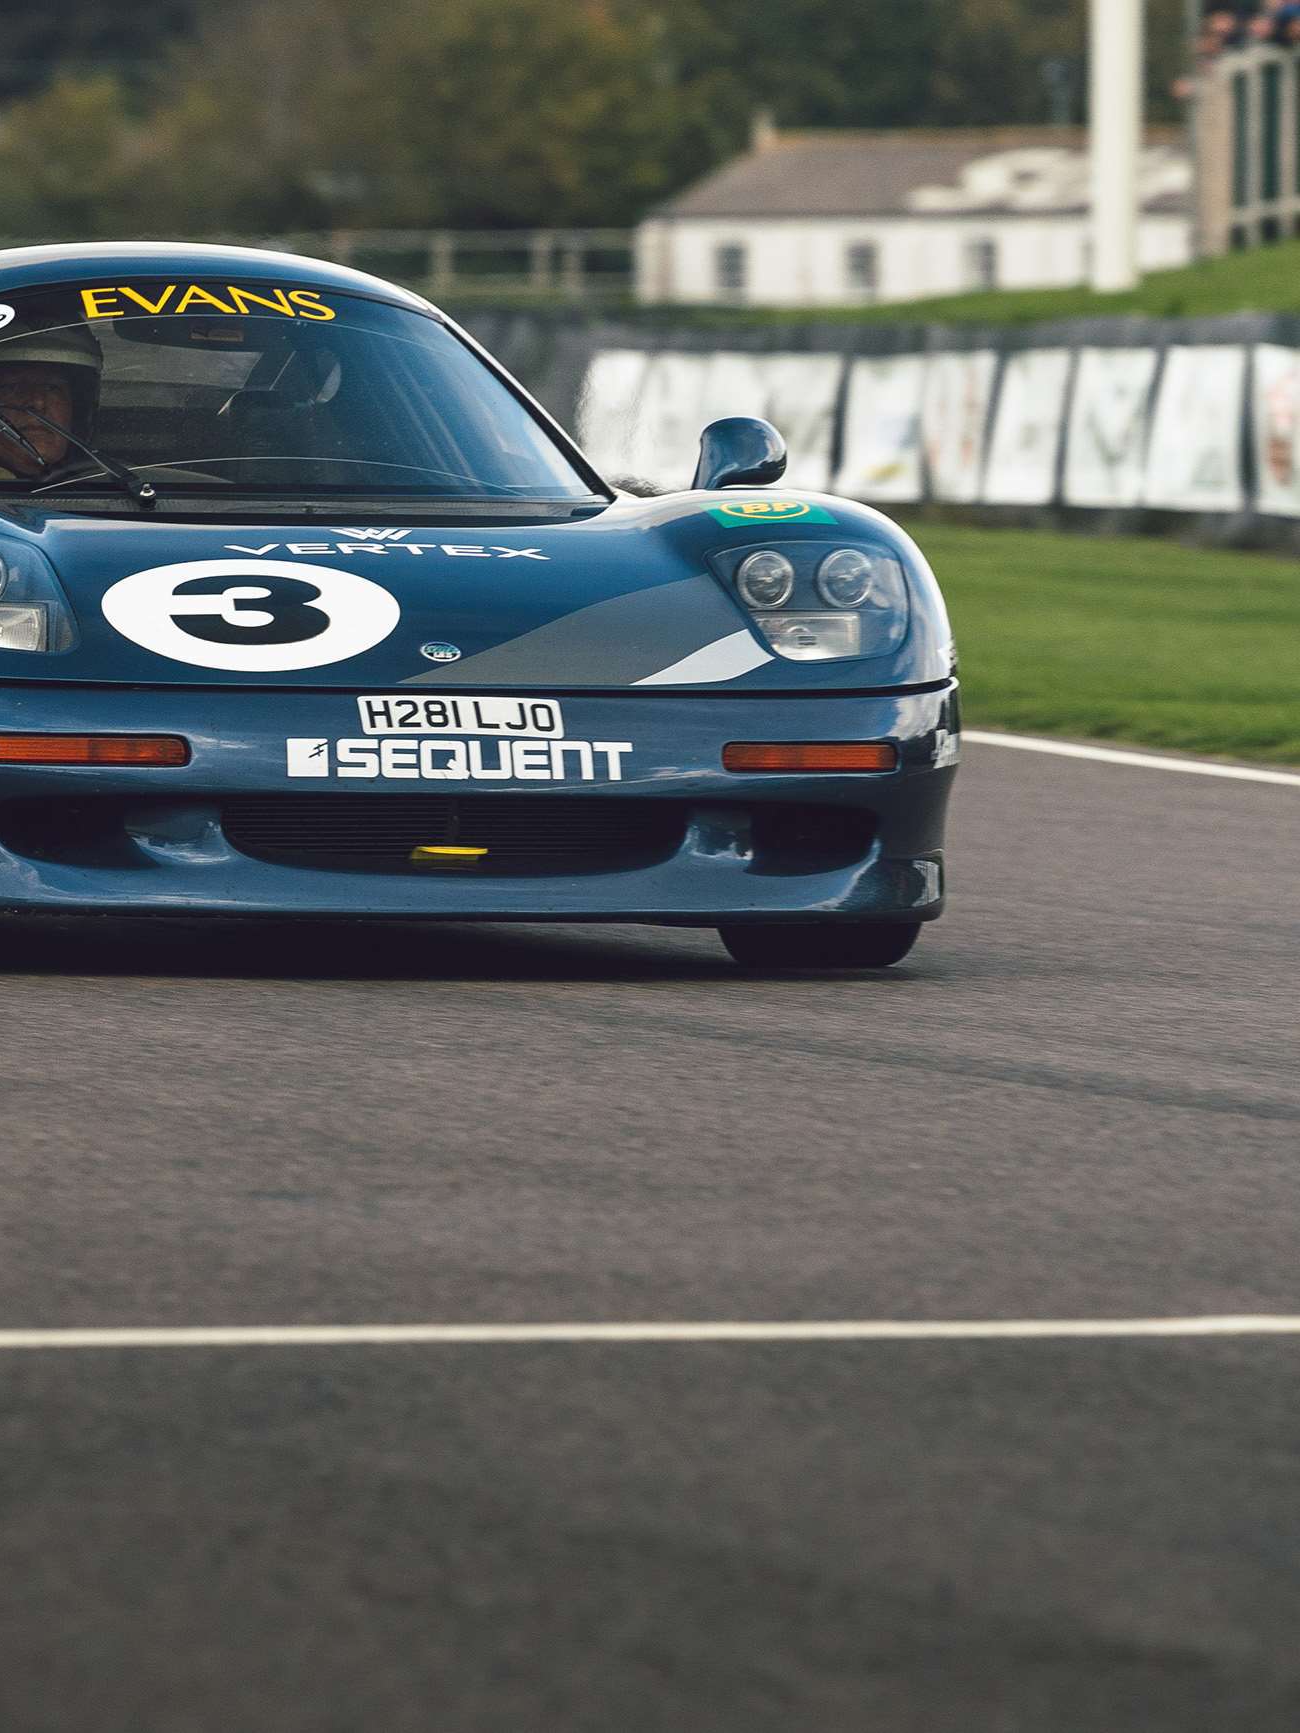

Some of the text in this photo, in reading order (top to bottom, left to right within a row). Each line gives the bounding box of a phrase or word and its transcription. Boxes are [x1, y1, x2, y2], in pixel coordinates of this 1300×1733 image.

[81, 285, 336, 321] EVANS
[741, 502, 798, 513] BP
[224, 543, 551, 560] VERTEX
[170, 574, 330, 645] 3
[366, 699, 556, 733] H281 LJO
[337, 739, 633, 781] SEQUENT
